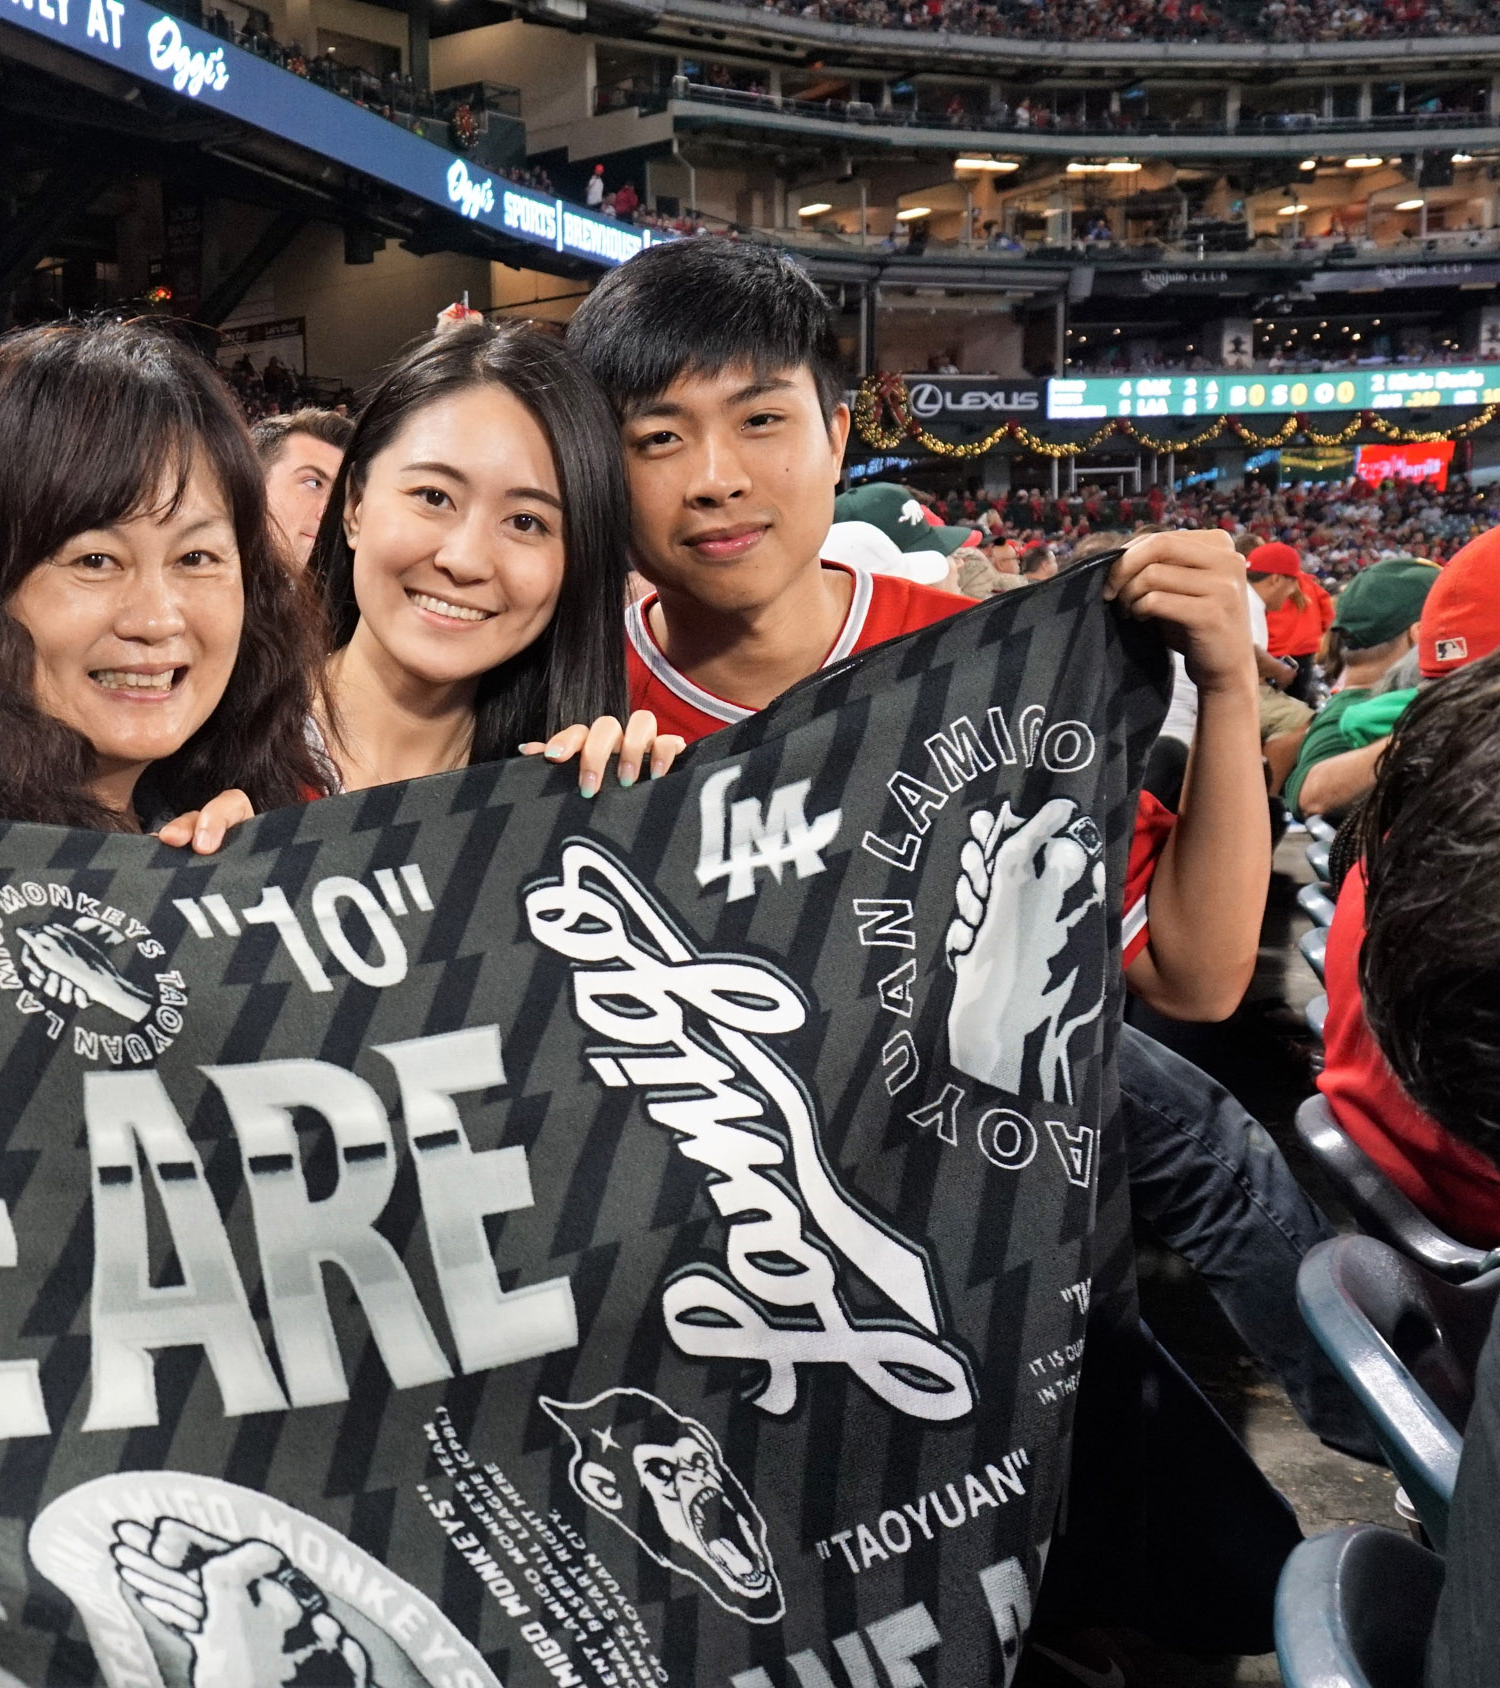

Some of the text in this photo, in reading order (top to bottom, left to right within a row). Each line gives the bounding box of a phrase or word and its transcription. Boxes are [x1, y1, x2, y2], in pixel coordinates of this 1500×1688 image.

[87, 0, 125, 49] AT
[148, 16, 230, 97] Oggi's
[447, 159, 495, 220] Oggi's
[504, 191, 557, 241] SPORTS
[946, 390, 1039, 412] LEXUS
[74, 969, 189, 1065] TAOYUAN
[852, 898, 1100, 1188] AOYUAN
[524, 836, 976, 1422] Lamigo
[81, 1025, 579, 1434] ARE
[1028, 1338, 1084, 1377] IT IS OU
[1037, 1386, 1058, 1406] IN
[469, 1473, 530, 1540] LEAGUE
[483, 1462, 527, 1507] HERE
[815, 1447, 1031, 1574] "TAOYUAN"
[423, 1422, 588, 1642] LAMIGO MONKEYS TEAM
[521, 1510, 572, 1562] RIGHT
[416, 1484, 587, 1688] MIGO MONKEYS"
[529, 1542, 604, 1632] BASEBALL
[566, 1566, 620, 1622] START
[584, 1553, 651, 1648] TAOYUAN
[615, 1624, 660, 1688] MENTS
[649, 1654, 669, 1683] OF
